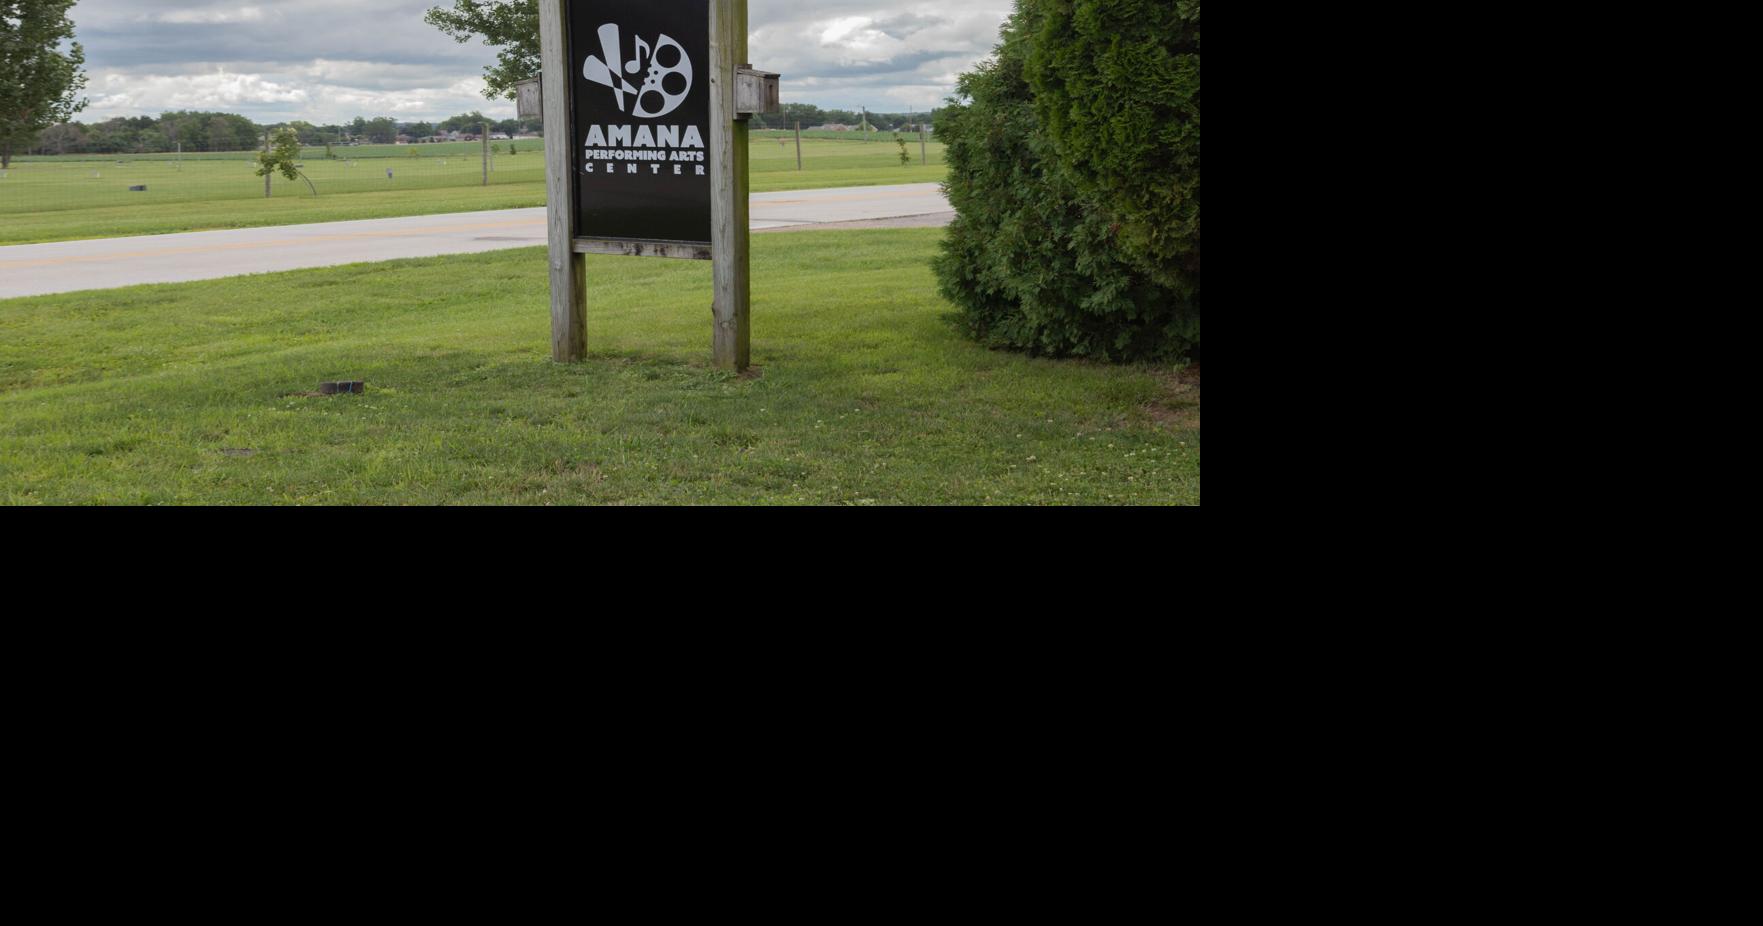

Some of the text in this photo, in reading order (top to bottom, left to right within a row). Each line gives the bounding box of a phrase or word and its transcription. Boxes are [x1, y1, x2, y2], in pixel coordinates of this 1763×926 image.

[585, 124, 704, 148] AMANA
[585, 150, 704, 162] PERFORMING ARTS
[585, 163, 705, 175] CENTER
